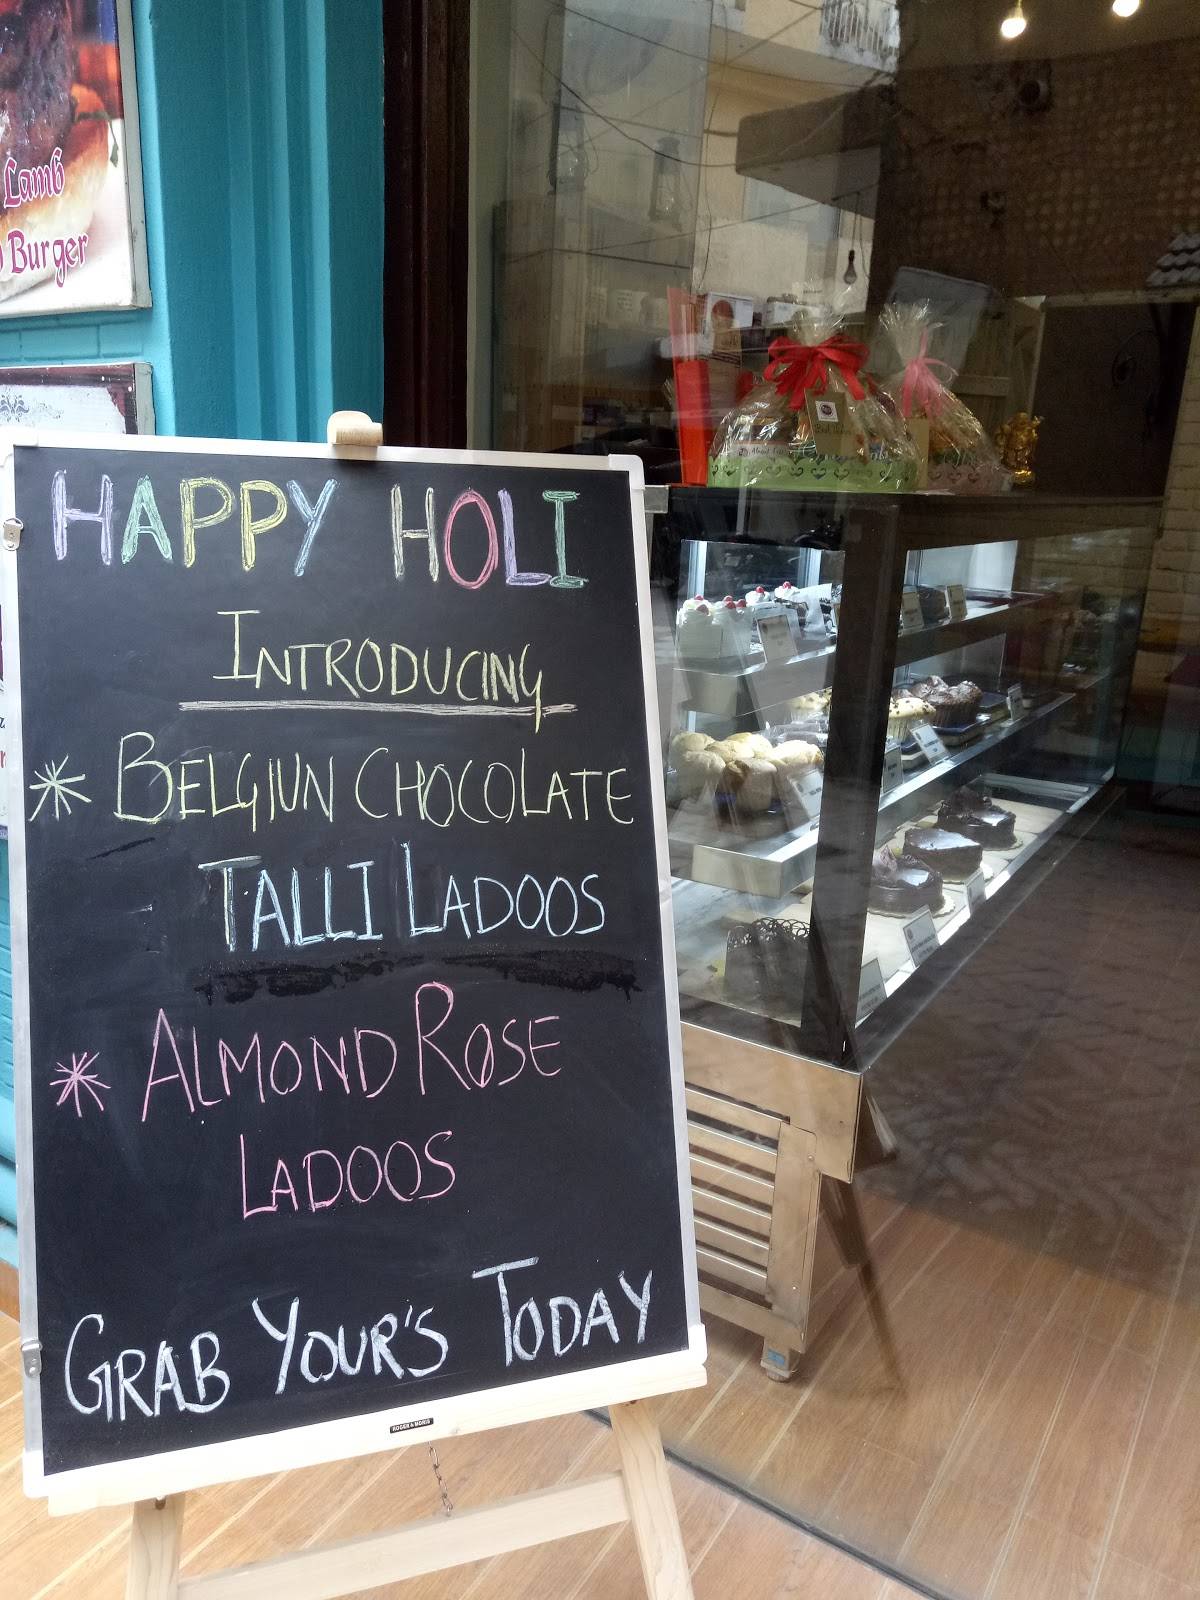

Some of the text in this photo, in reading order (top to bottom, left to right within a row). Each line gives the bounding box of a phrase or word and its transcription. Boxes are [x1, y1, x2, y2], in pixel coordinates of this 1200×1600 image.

[4, 147, 65, 208] Lamb
[7, 229, 88, 288] Burger
[50, 469, 590, 590] HAPPY HOLI
[212, 609, 545, 734] INTRODUCING
[354, 747, 634, 828] CHOCOLATE
[197, 840, 606, 952] TALLI LADOOS
[141, 981, 562, 1122] ALMOND ROSE
[240, 1130, 456, 1220] LADOOS
[64, 1257, 653, 1423] GRAB YOUR'S TODAY
